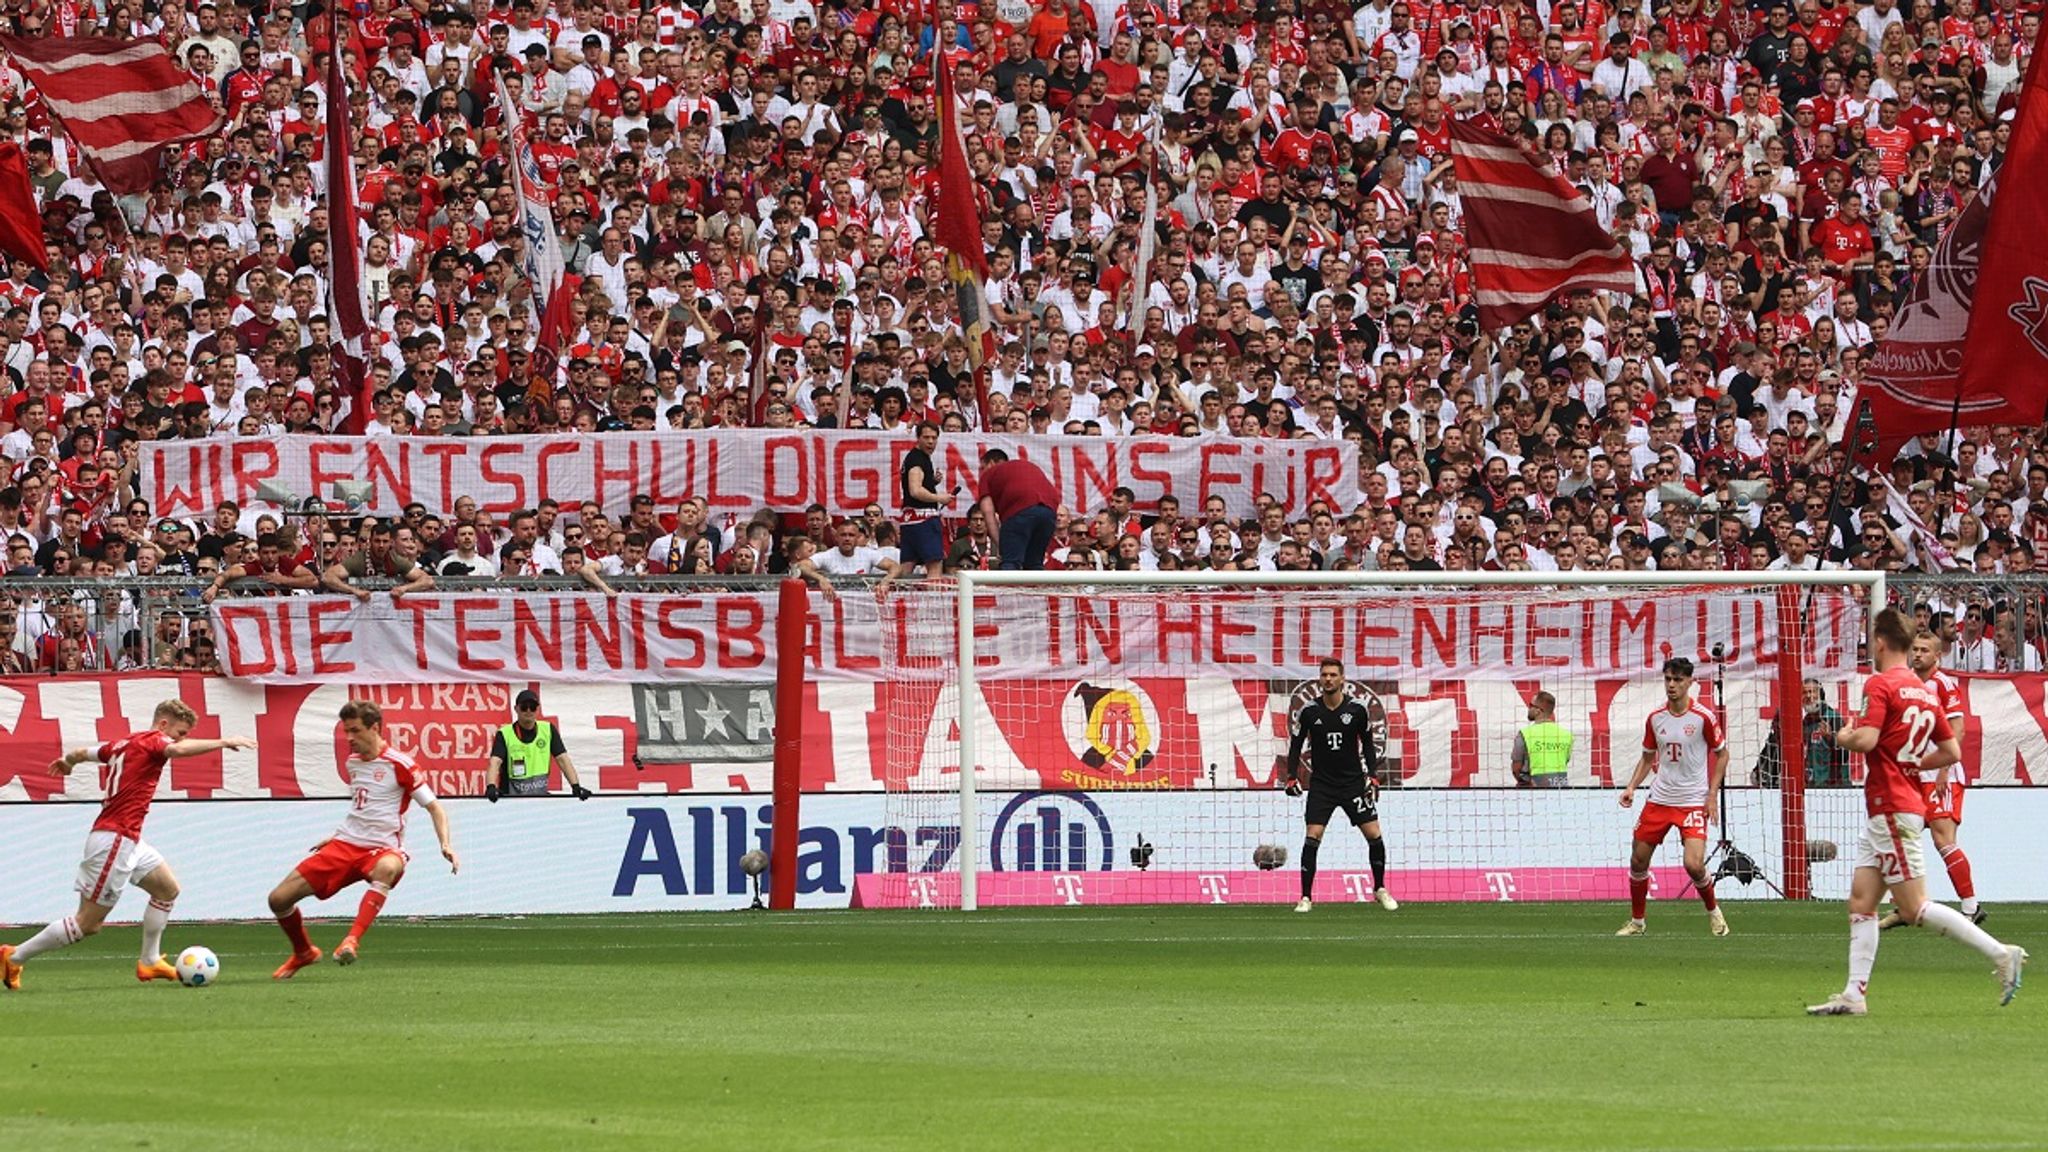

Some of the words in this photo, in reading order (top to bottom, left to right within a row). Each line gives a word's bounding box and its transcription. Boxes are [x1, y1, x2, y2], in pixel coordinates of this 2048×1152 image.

[153, 440, 279, 519] WIR
[219, 600, 356, 677] DIE
[1047, 595, 1121, 666] IN
[1897, 705, 1936, 767] 22
[1683, 810, 1705, 828] 45
